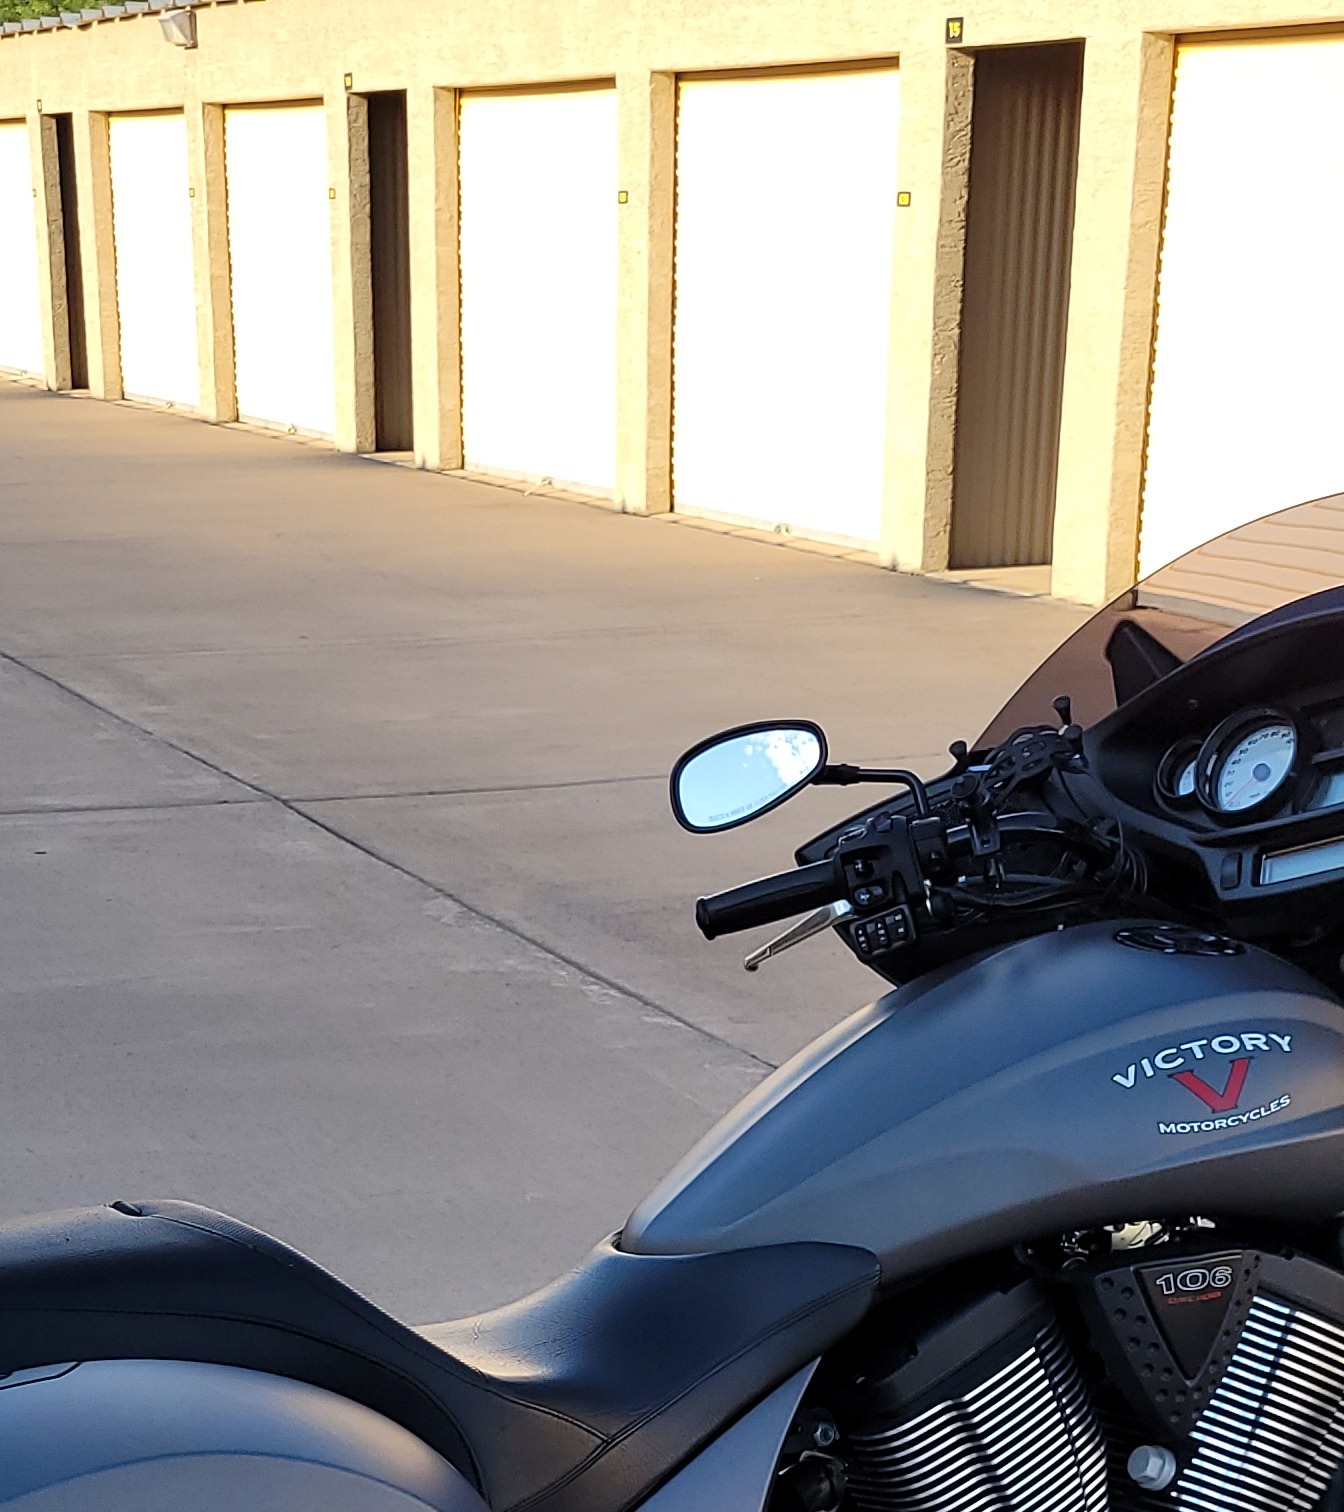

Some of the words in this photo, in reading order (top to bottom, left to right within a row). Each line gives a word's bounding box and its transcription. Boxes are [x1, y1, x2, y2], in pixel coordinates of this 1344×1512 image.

[1112, 1031, 1293, 1090] VICTORY
[1158, 1094, 1291, 1134] MOTORCYCLES
[1156, 1266, 1233, 1295] 106
